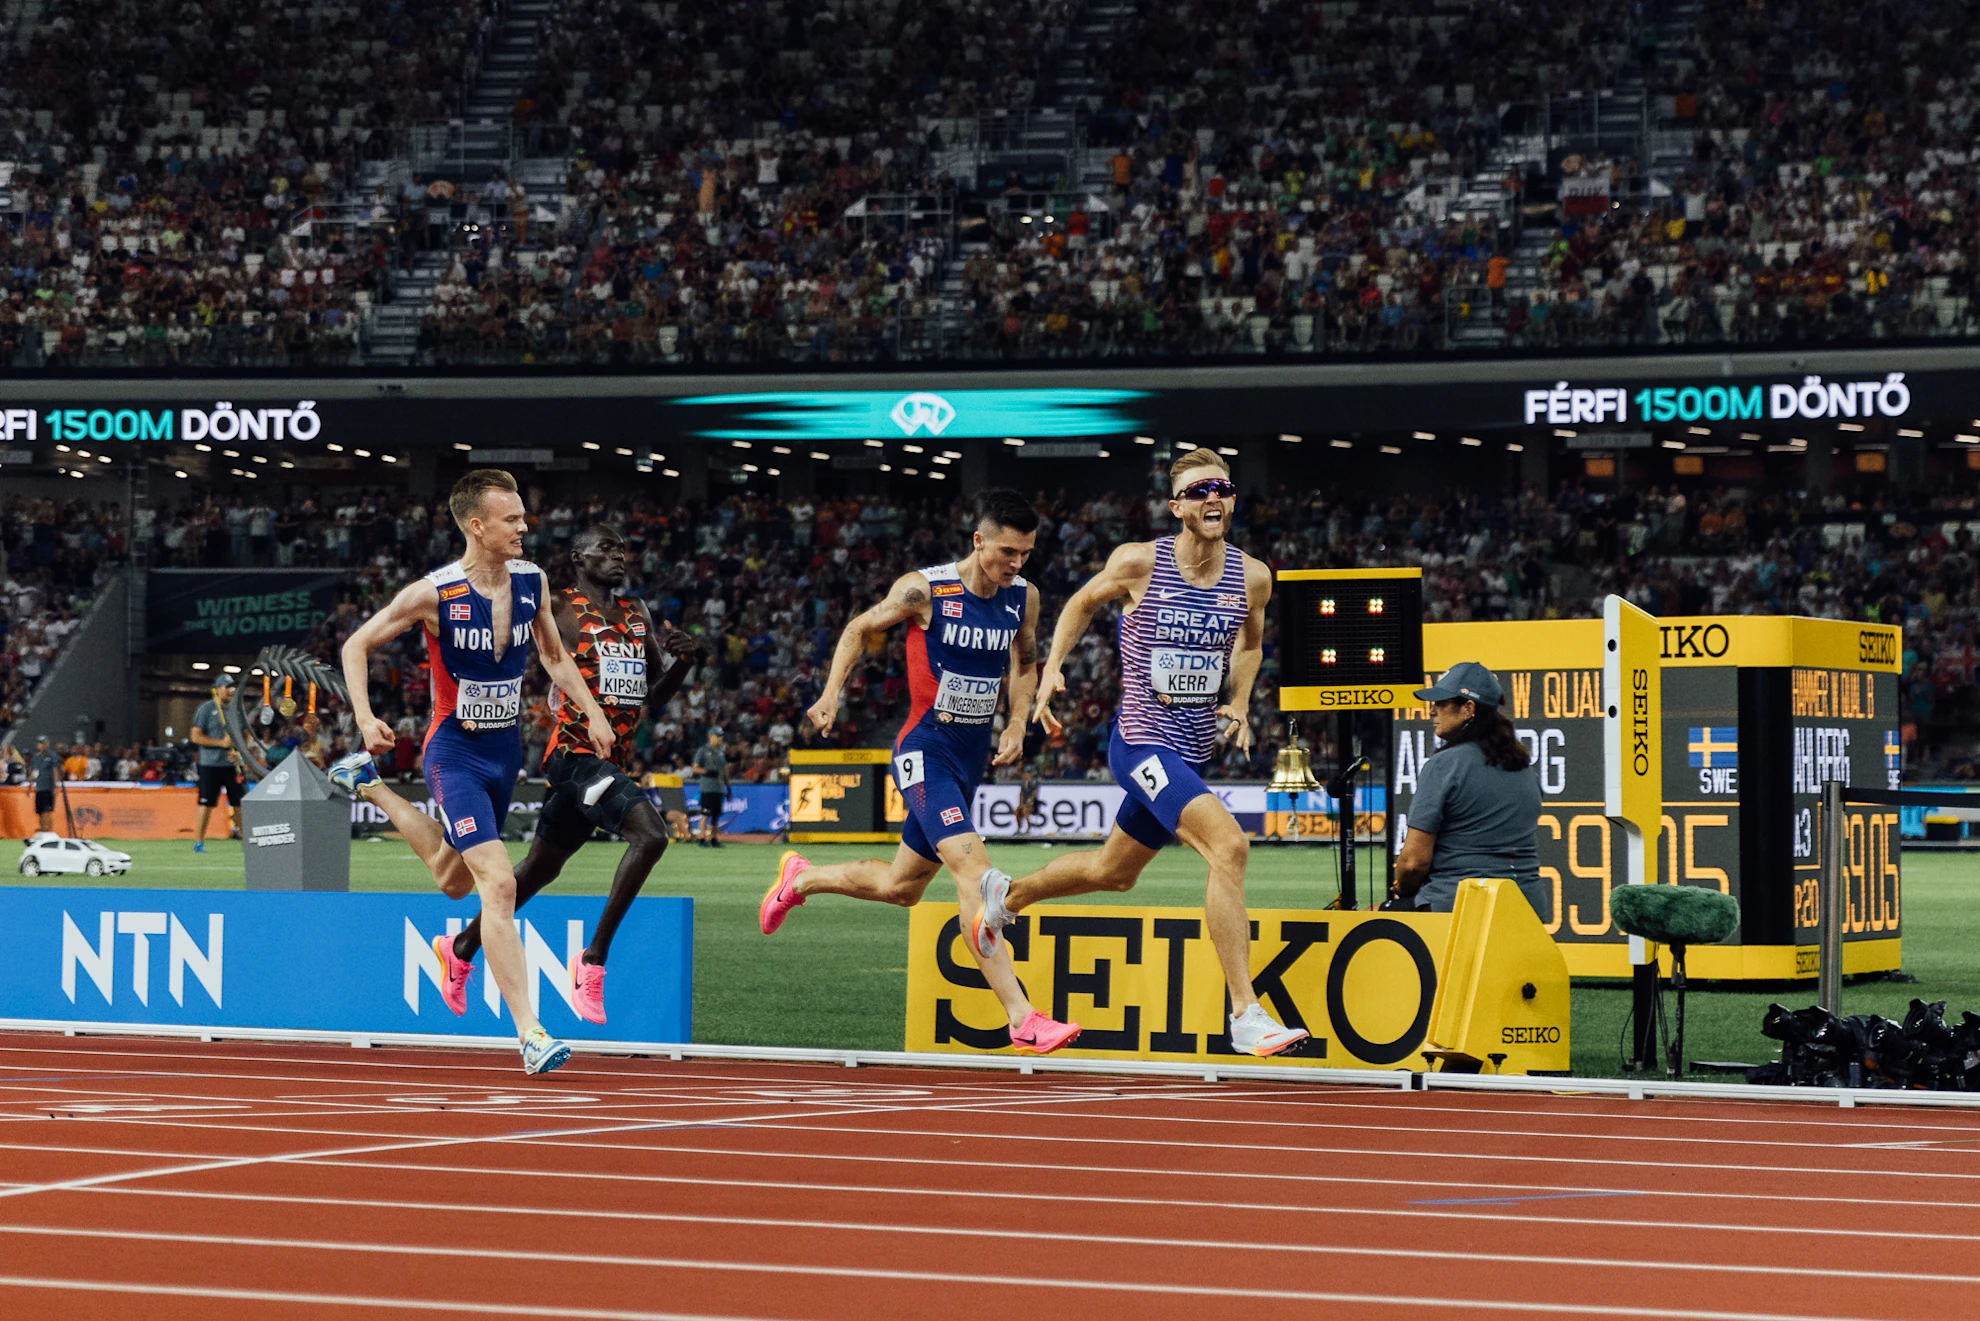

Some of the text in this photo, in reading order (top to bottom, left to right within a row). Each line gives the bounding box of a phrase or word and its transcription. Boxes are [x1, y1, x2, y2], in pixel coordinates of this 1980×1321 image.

[1525, 372, 1910, 424] FÉRFI 1500M DÖNTŐ
[45, 409, 173, 441] 1500M
[181, 400, 321, 441] DÖNTŐ
[197, 592, 311, 617] WITNESS
[1157, 608, 1234, 631] GREAT
[1155, 626, 1230, 645] BRITAIN
[1660, 624, 1729, 657] IKO
[1859, 630, 1896, 665] SEIKO
[619, 660, 646, 676] TD
[1175, 654, 1220, 671] TDK
[482, 682, 518, 699] TDK
[963, 679, 1000, 695] TDK
[1168, 674, 1208, 691] KERR
[937, 697, 945, 709] J.
[1320, 689, 1394, 706] SEIKO
[1511, 672, 1531, 718] W
[462, 701, 517, 718] NORDÅS
[1633, 669, 1648, 776] SEIKO
[903, 759, 913, 781] 9
[1141, 767, 1157, 791] 5
[1700, 768, 1738, 794] SWE
[62, 910, 223, 1009] NTN
[935, 914, 1437, 1064] SEIKO
[1501, 1027, 1560, 1044] SEIKO
